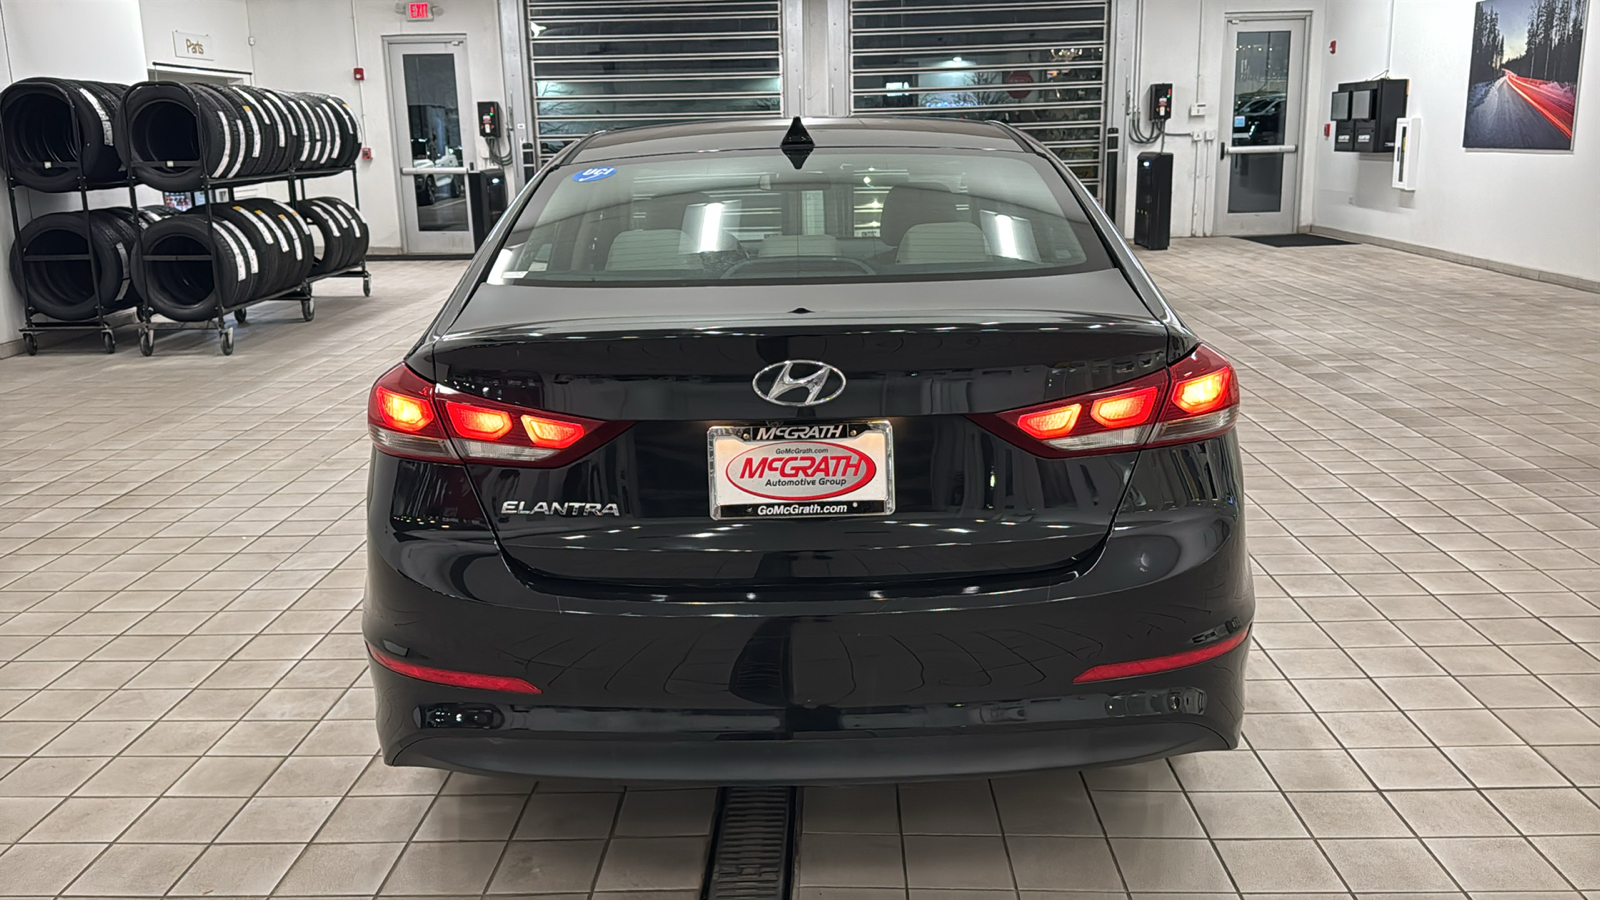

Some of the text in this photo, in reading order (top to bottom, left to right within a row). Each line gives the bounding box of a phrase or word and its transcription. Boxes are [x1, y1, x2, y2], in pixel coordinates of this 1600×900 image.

[409, 2, 429, 18] EXIT
[185, 38, 204, 55] Parts
[775, 447, 829, 455] GoMcGrath.com
[765, 477, 847, 487] Automotive Group
[500, 500, 620, 517] ELANTRA
[757, 503, 848, 516] GoMcGrath.com
